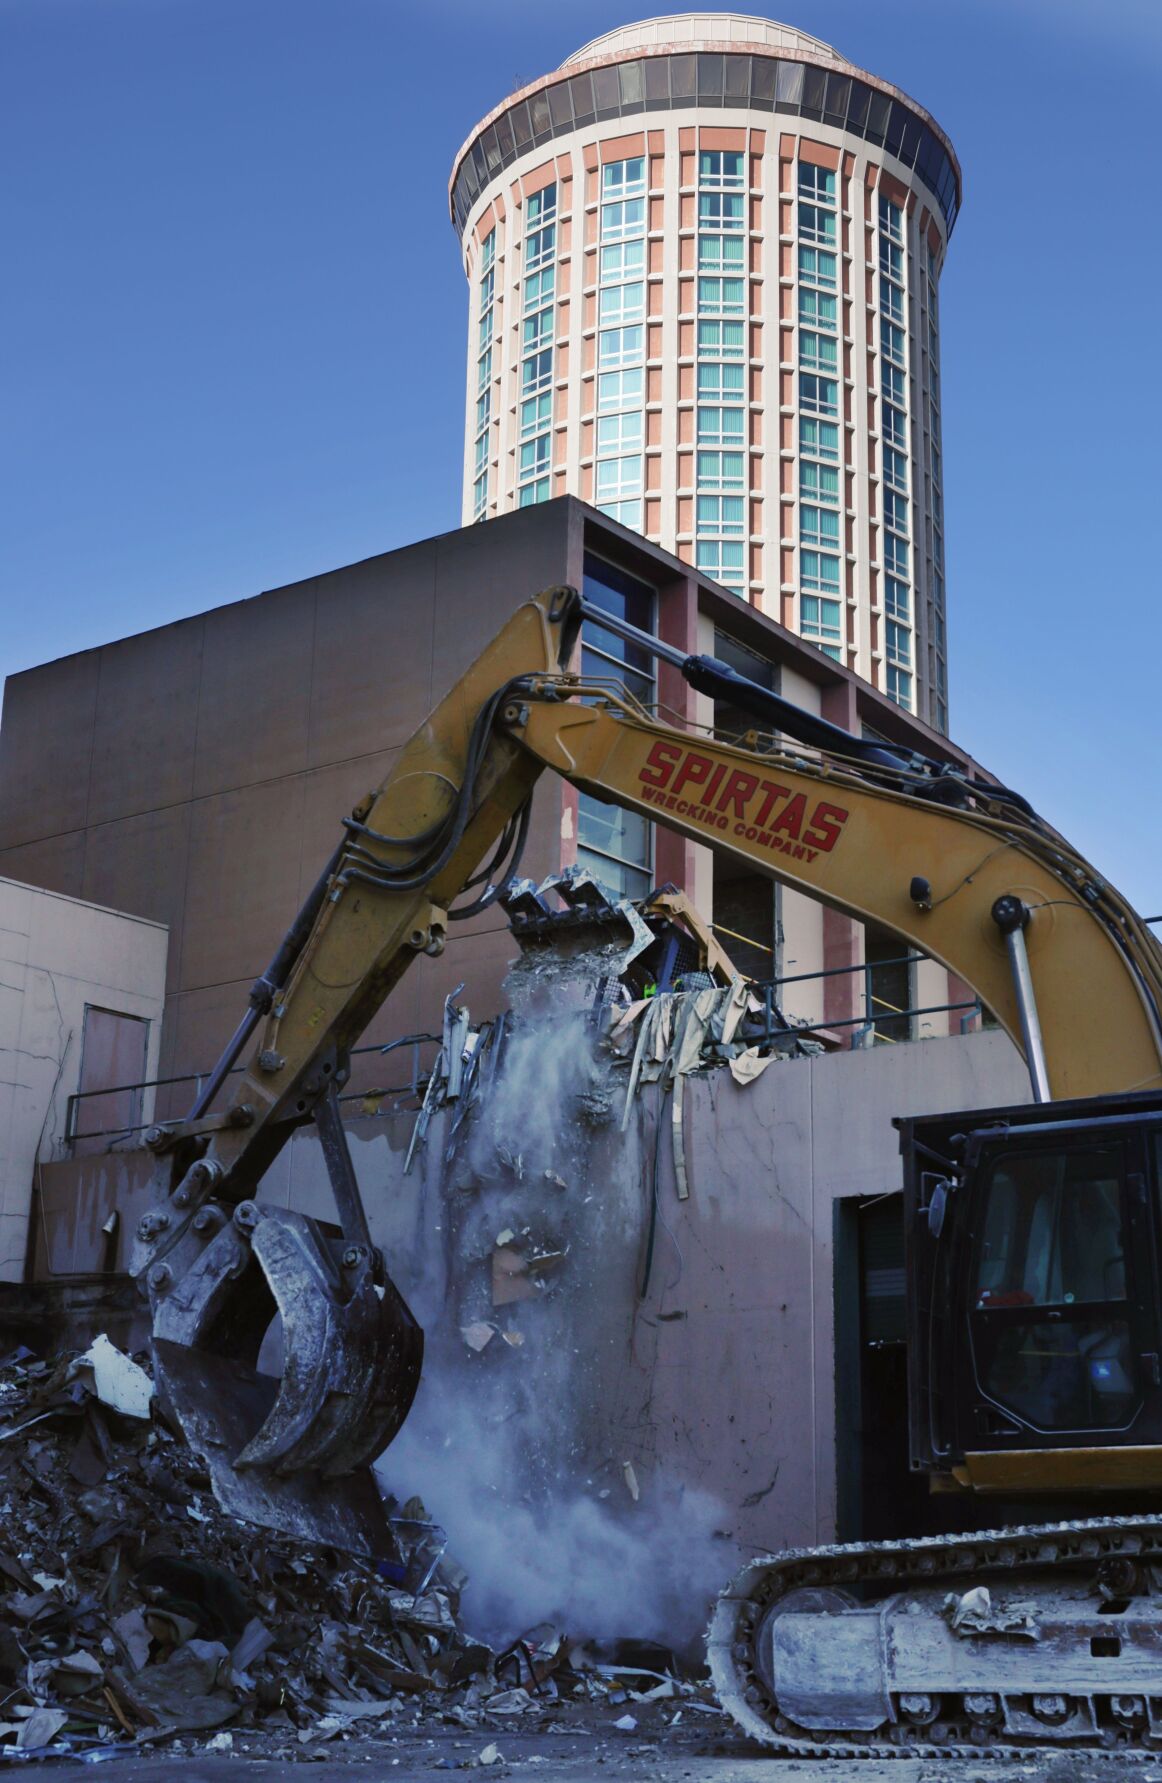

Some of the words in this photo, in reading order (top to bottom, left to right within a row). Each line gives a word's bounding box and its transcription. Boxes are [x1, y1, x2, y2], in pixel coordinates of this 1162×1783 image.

[639, 741, 849, 852] SPIRTAS
[641, 786, 729, 830] WRECKING
[734, 822, 819, 864] COMPANY
